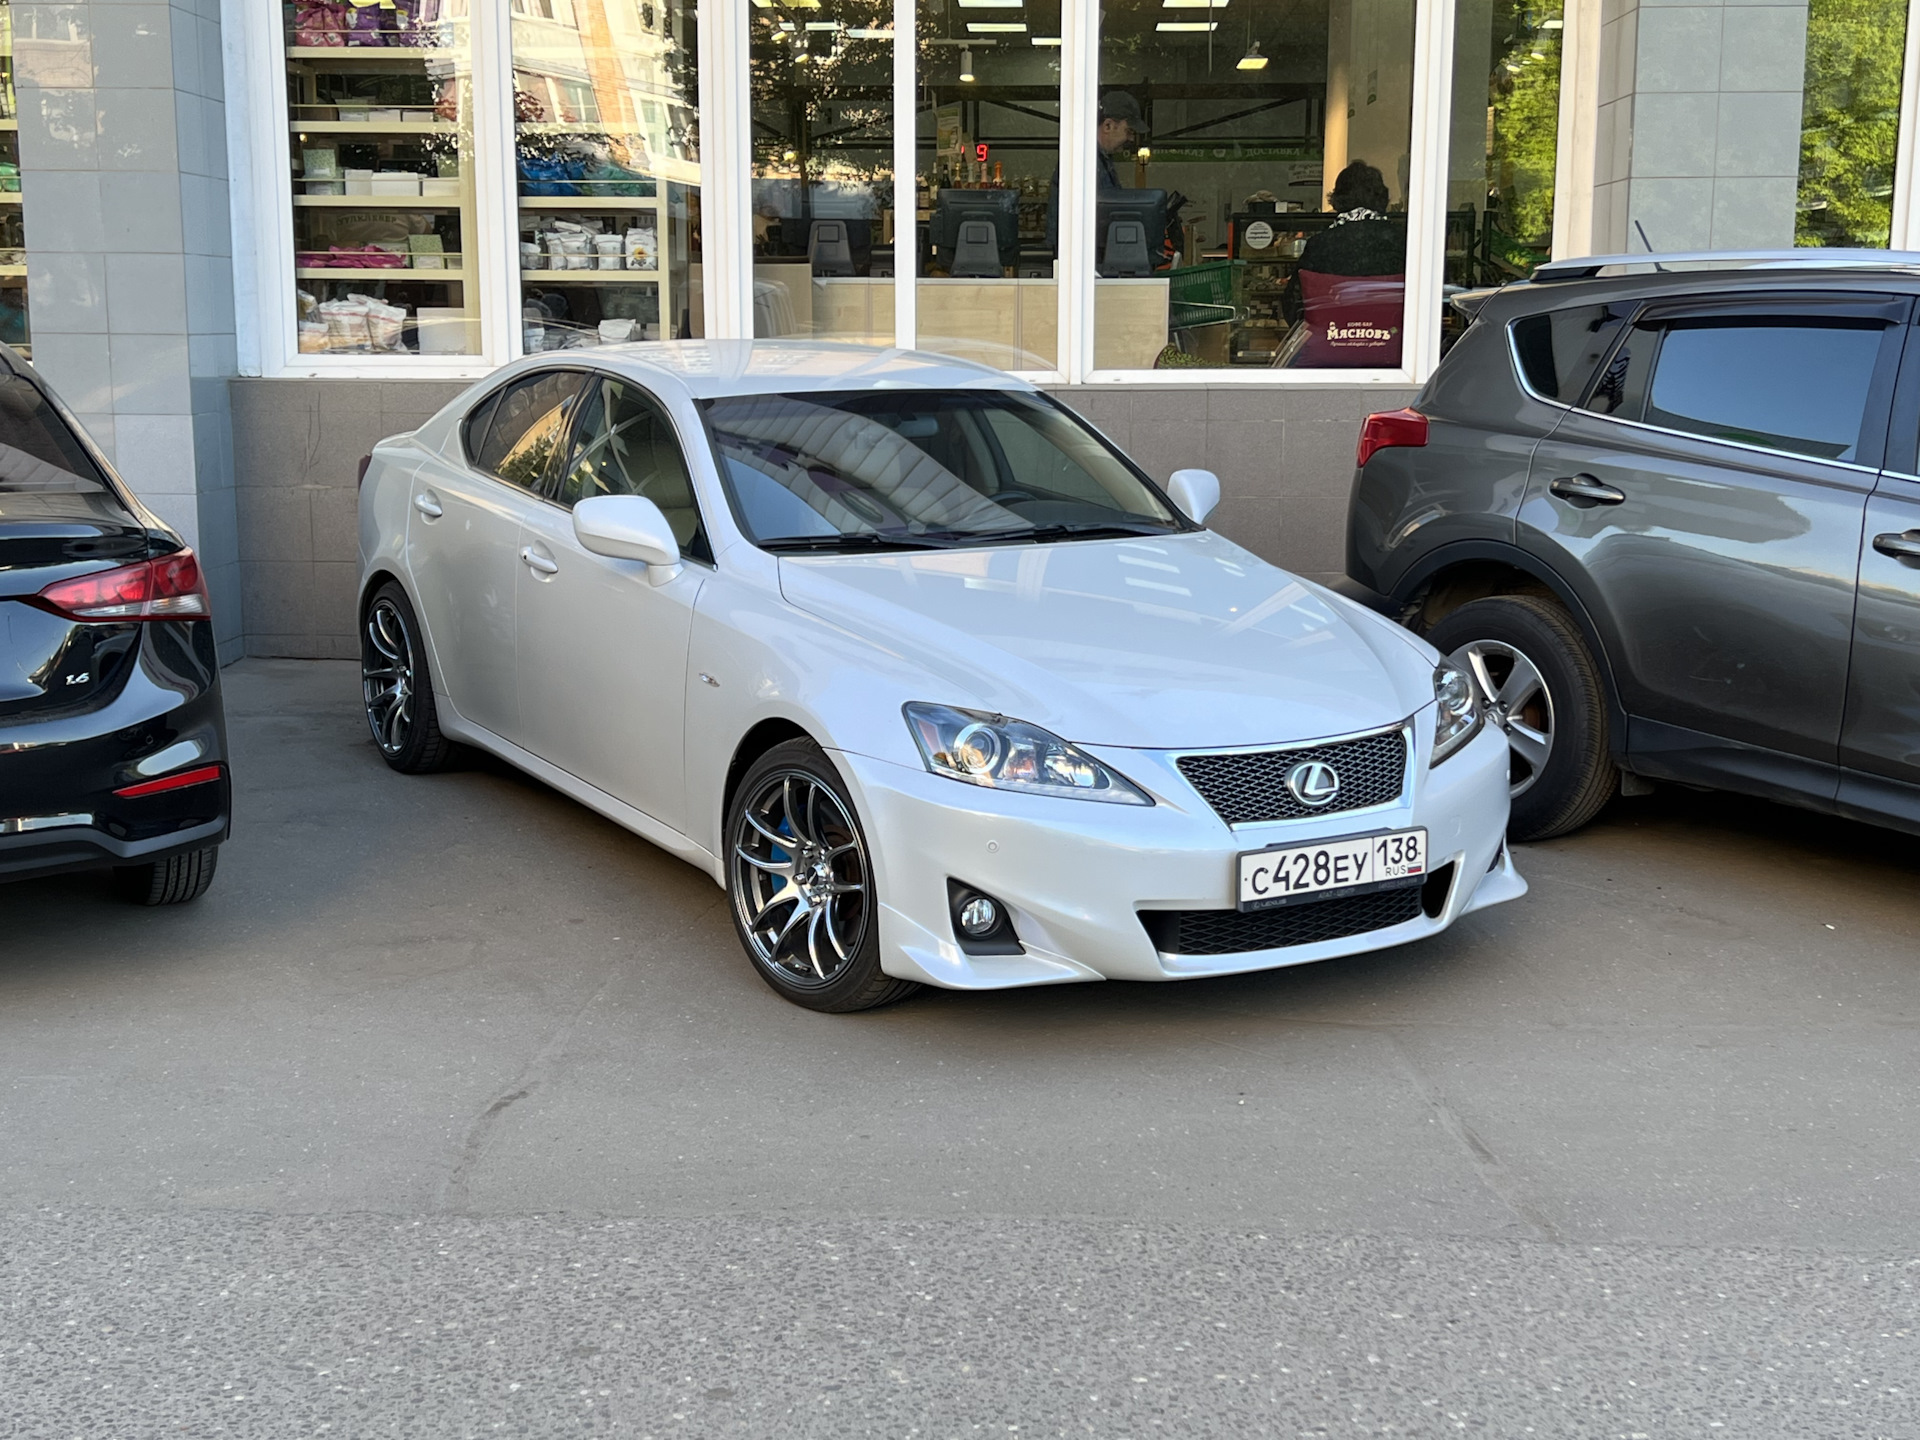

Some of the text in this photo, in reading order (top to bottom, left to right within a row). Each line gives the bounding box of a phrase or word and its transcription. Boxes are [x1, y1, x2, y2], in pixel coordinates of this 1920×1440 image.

[65, 672, 90, 686] 1.6
[1251, 835, 1418, 895] С428ЕУ 138
[1385, 864, 1407, 877] RUS
